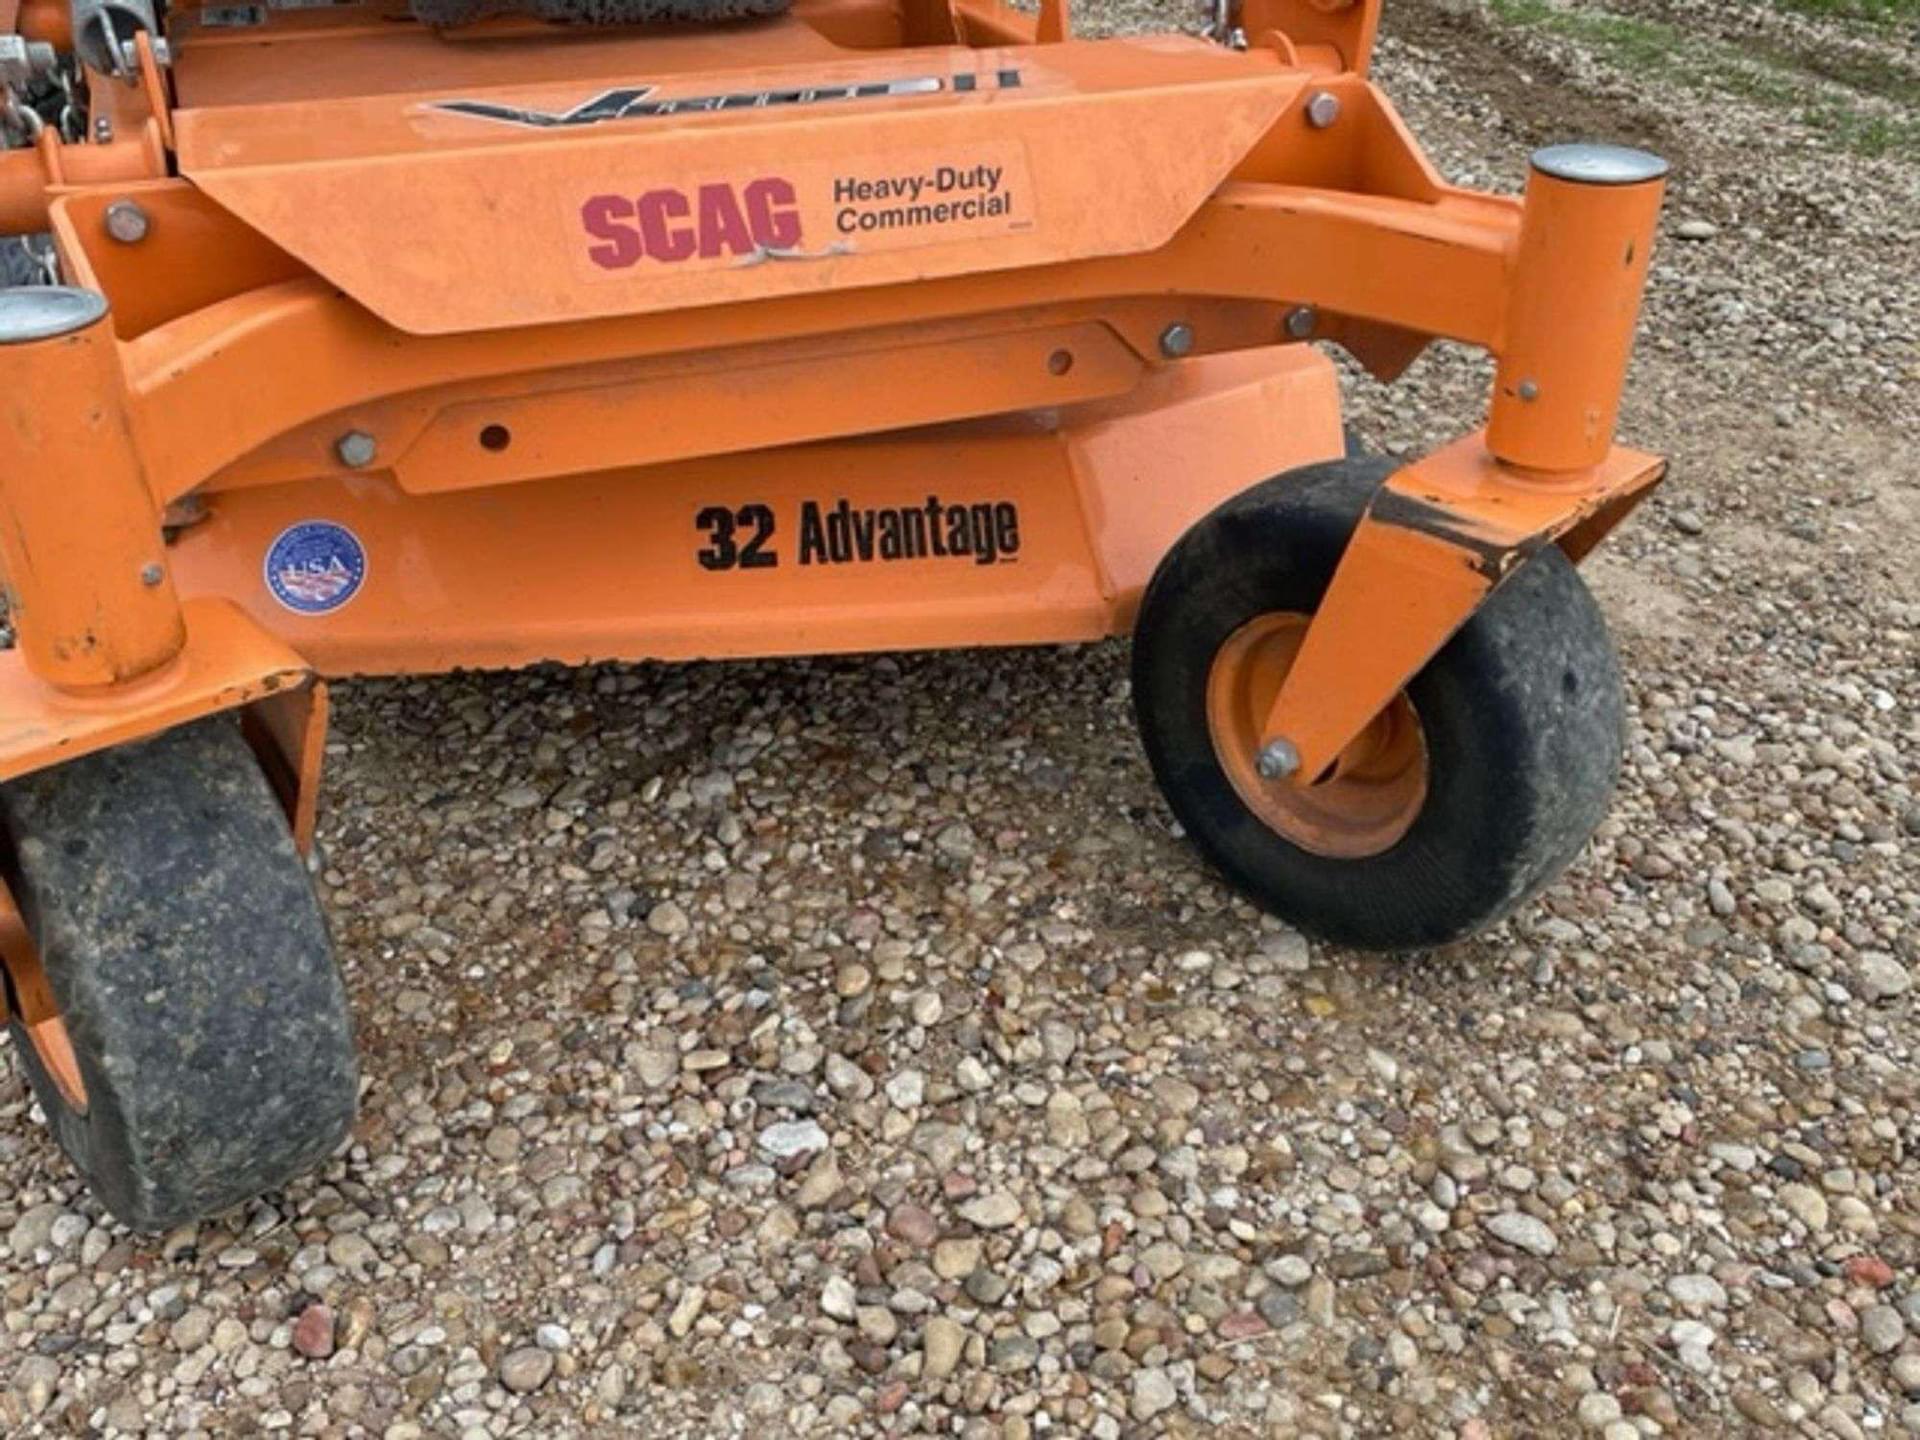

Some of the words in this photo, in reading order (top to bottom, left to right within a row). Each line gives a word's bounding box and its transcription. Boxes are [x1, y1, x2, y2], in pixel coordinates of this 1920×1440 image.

[834, 164, 1003, 202] Heavy-Duty
[581, 177, 802, 270] SCAG
[836, 192, 1011, 233] Commercial
[696, 504, 777, 570] 32
[798, 495, 1020, 564] Advantage
